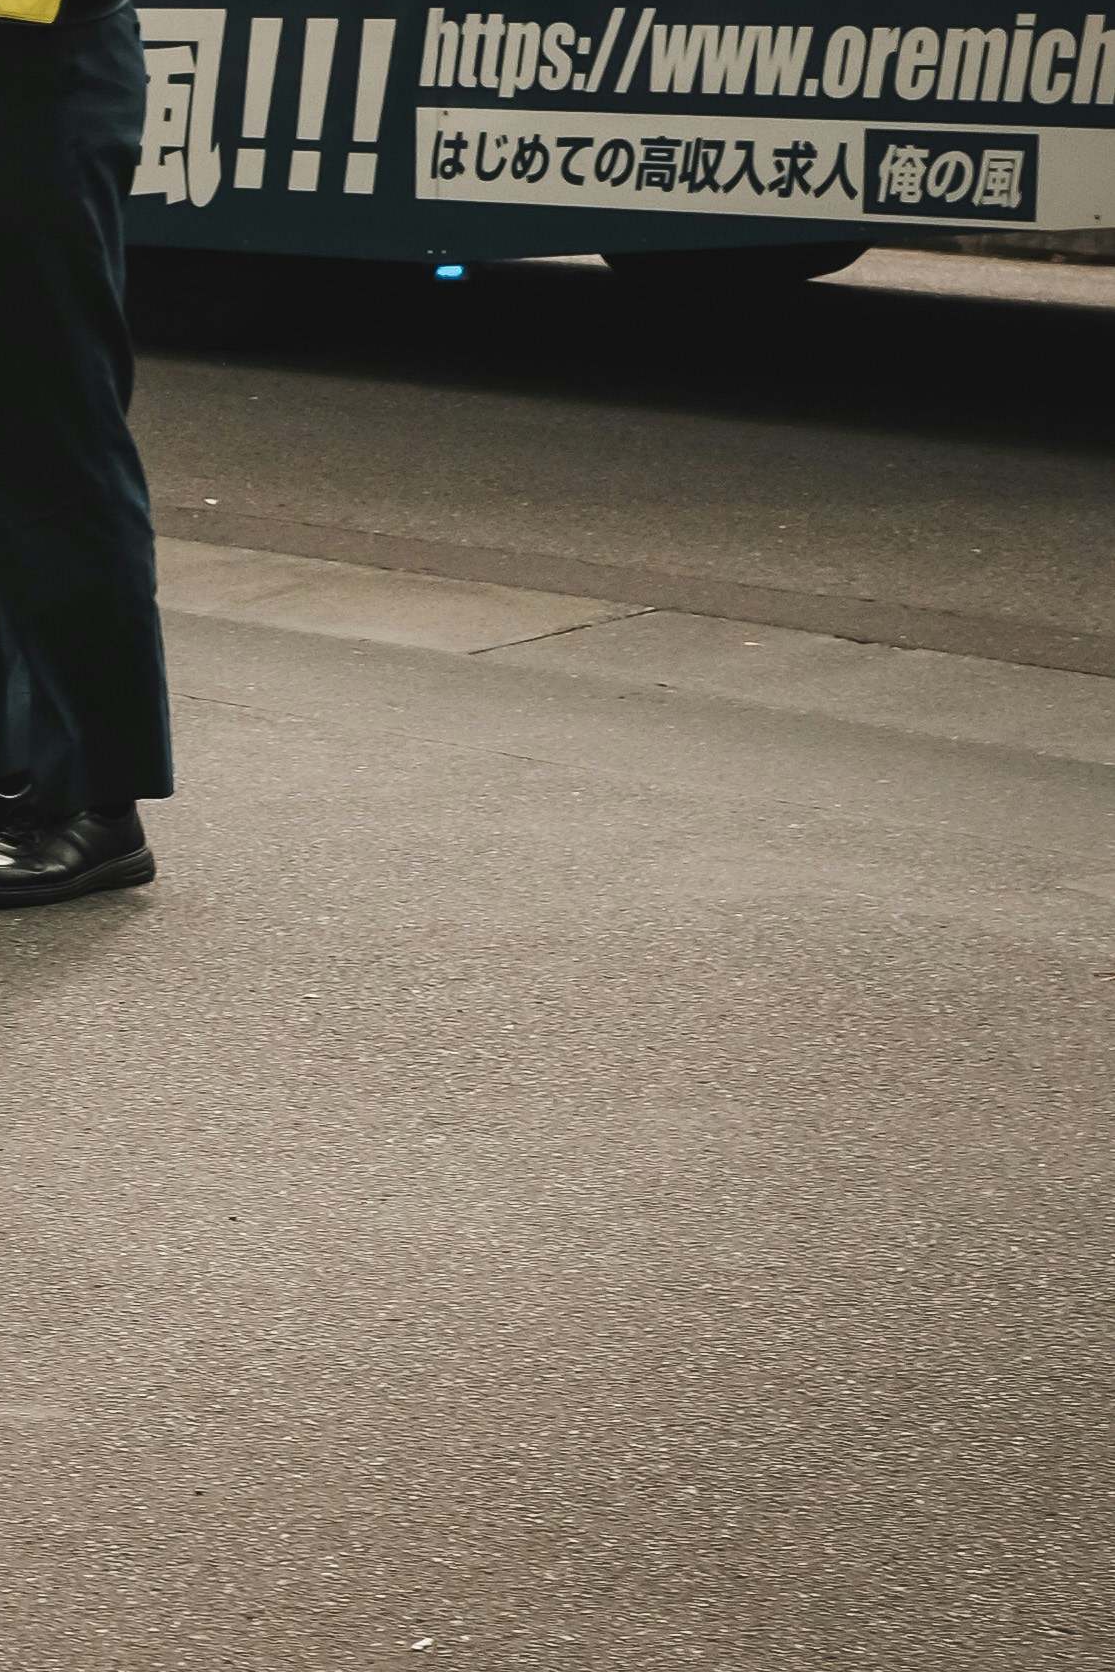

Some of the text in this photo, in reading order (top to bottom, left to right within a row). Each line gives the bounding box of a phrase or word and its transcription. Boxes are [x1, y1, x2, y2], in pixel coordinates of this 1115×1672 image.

[418, 7, 1115, 106] https://www.oremich
[429, 129, 1026, 209] はじめての高収入求人 俺の風
